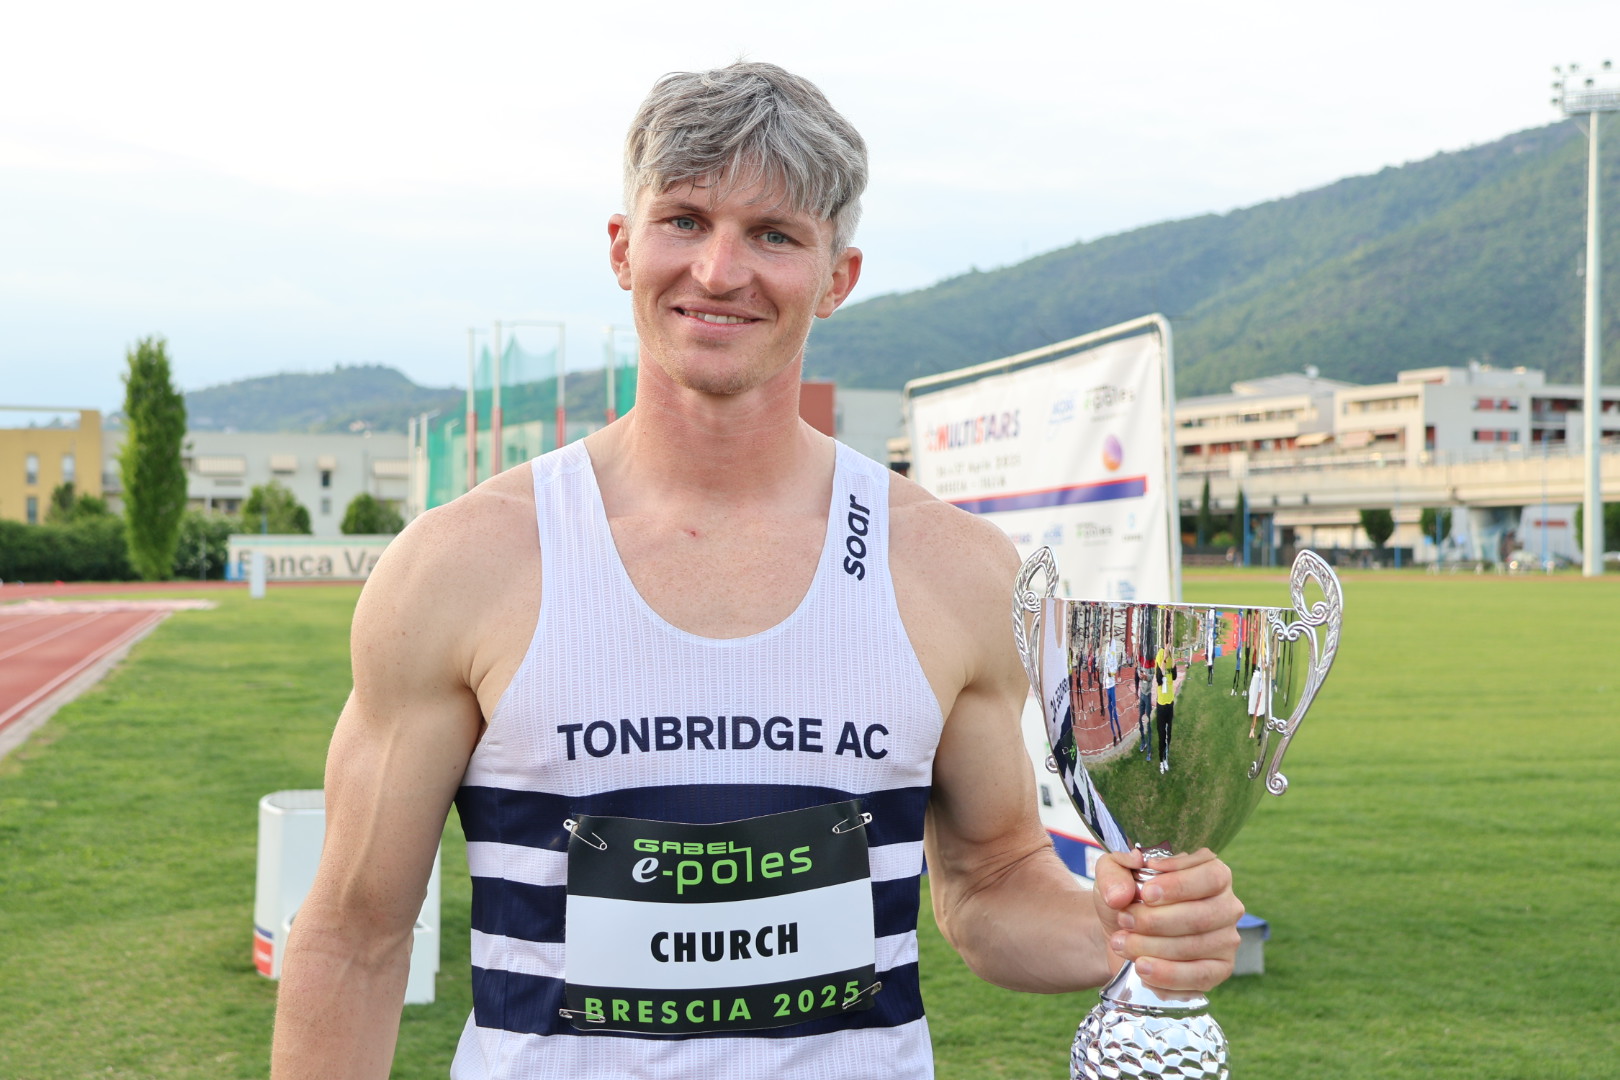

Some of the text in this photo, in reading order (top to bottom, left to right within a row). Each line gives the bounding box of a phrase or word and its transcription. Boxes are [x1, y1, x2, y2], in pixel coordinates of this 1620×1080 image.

[844, 494, 870, 581] soar
[557, 716, 889, 761] TONBRIDGE AC
[633, 838, 735, 855] GABEL
[632, 846, 813, 895] e-poles
[650, 922, 798, 963] CHURCH
[585, 980, 860, 1024] BRESCIA 2025
